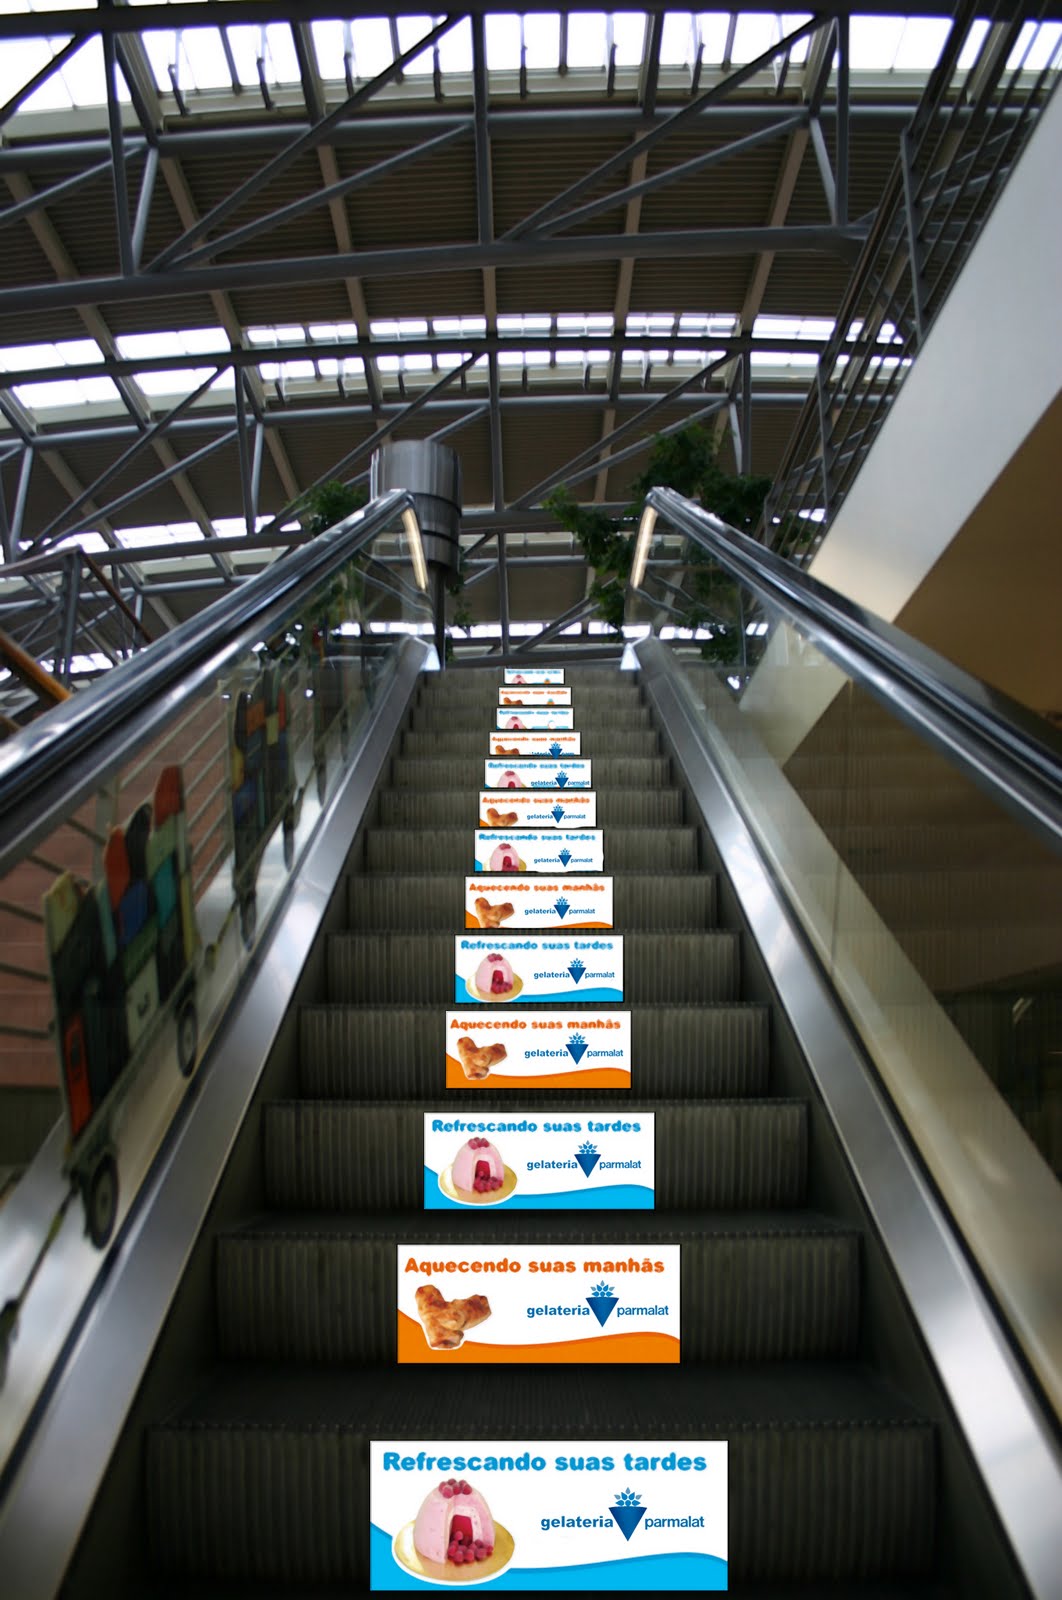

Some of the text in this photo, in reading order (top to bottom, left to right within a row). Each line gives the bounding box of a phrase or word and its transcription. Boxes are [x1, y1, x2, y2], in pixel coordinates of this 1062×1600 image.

[469, 883, 530, 893] Aquecendo
[461, 940, 613, 950] Refrescando suas tardes
[534, 971, 615, 980] gelateria parmalat
[450, 1019, 527, 1031] Aquecendo
[531, 1021, 563, 1029] suas
[524, 1049, 623, 1058] gelateria parmalat
[432, 1119, 641, 1132] Refrescando suas tardes
[527, 1160, 641, 1170] gelateria parmalat
[404, 1257, 665, 1276] Aquecendo suas manhãs
[527, 1305, 669, 1318] gelateria parmalat
[383, 1452, 707, 1471] Refrescando suas tardes
[541, 1515, 705, 1530] gelateria parmalat
